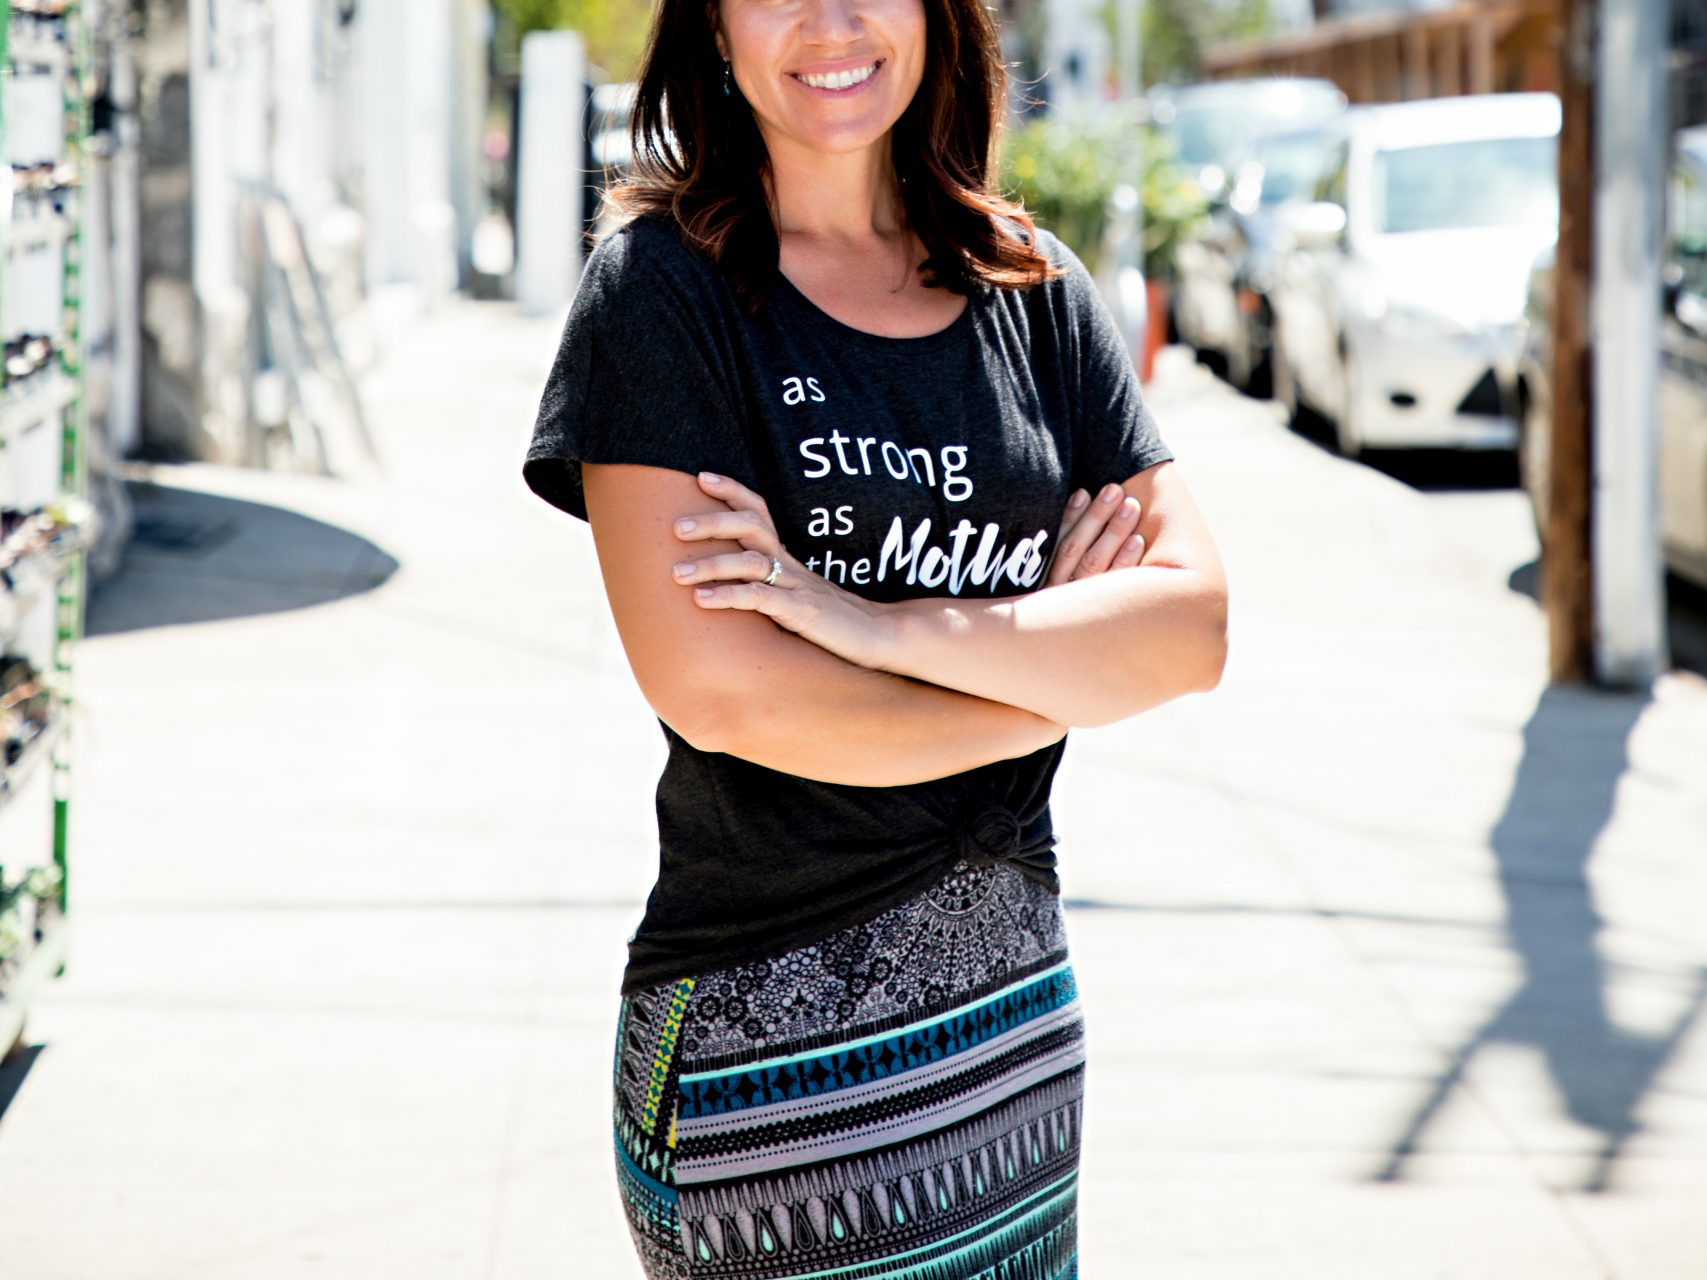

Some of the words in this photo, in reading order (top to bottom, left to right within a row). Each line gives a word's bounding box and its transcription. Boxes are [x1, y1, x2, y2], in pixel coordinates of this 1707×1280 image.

[782, 376, 826, 406] as
[799, 429, 974, 502] strong
[807, 505, 854, 537] as
[805, 550, 871, 585] the
[877, 516, 1049, 596] Mother
